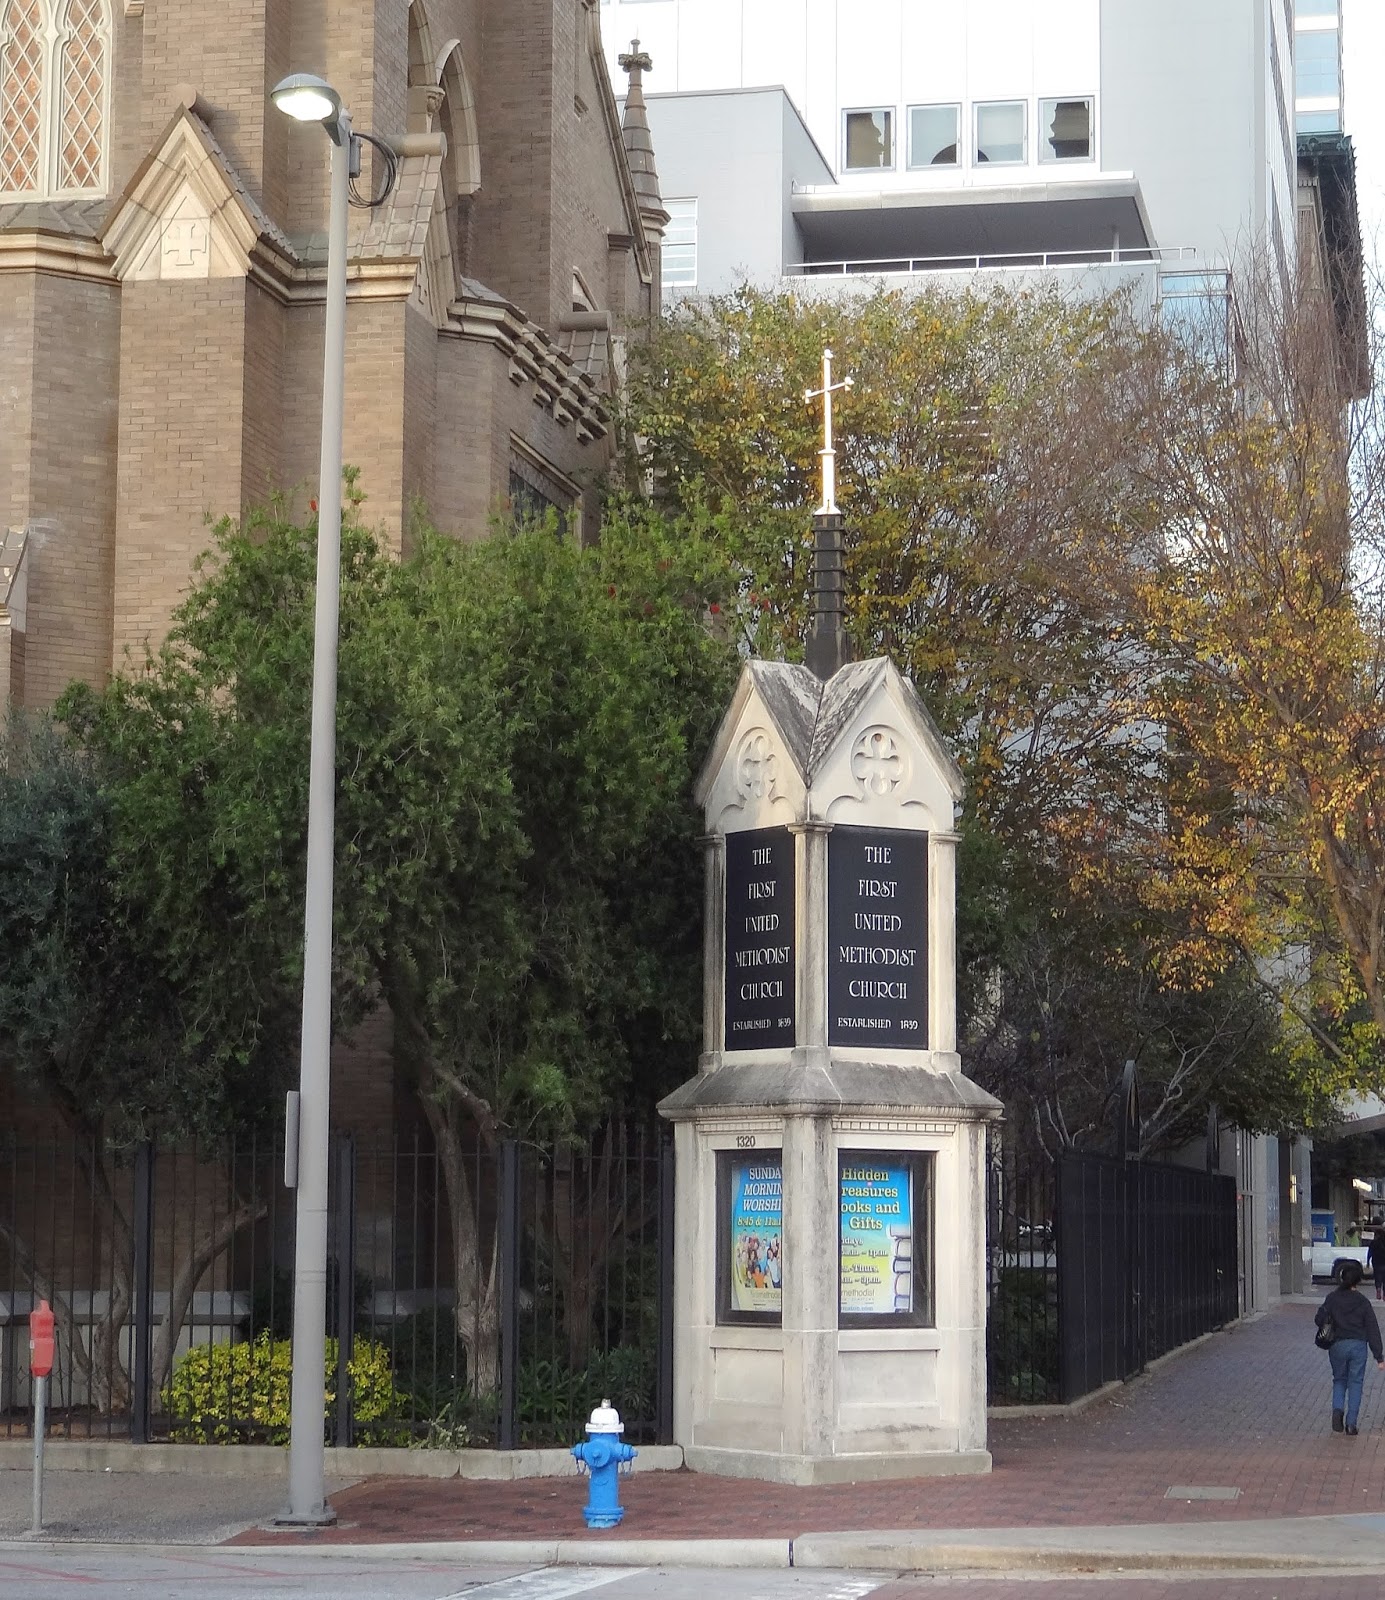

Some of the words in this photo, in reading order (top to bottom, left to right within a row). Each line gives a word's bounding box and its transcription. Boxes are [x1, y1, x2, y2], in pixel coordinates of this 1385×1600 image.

[752, 847, 772, 865] THE
[865, 846, 892, 864] THE
[748, 880, 776, 899] FIRST
[858, 879, 898, 898] FIRST
[745, 914, 779, 932] UNITED
[854, 913, 902, 931] UNITED
[735, 946, 790, 967] METHODIST
[839, 945, 916, 966] METHODIST
[740, 980, 783, 1000] CHURCH
[848, 980, 907, 1000] CHURCH
[732, 1019, 772, 1031] ESTABLISHED
[837, 1017, 892, 1029] ESTABLISHED
[735, 1135, 756, 1148] 1320
[749, 1167, 782, 1180] SUNDA
[841, 1167, 889, 1181] Hidden
[875, 1201, 901, 1213] and
[849, 1216, 883, 1229] Gifts
